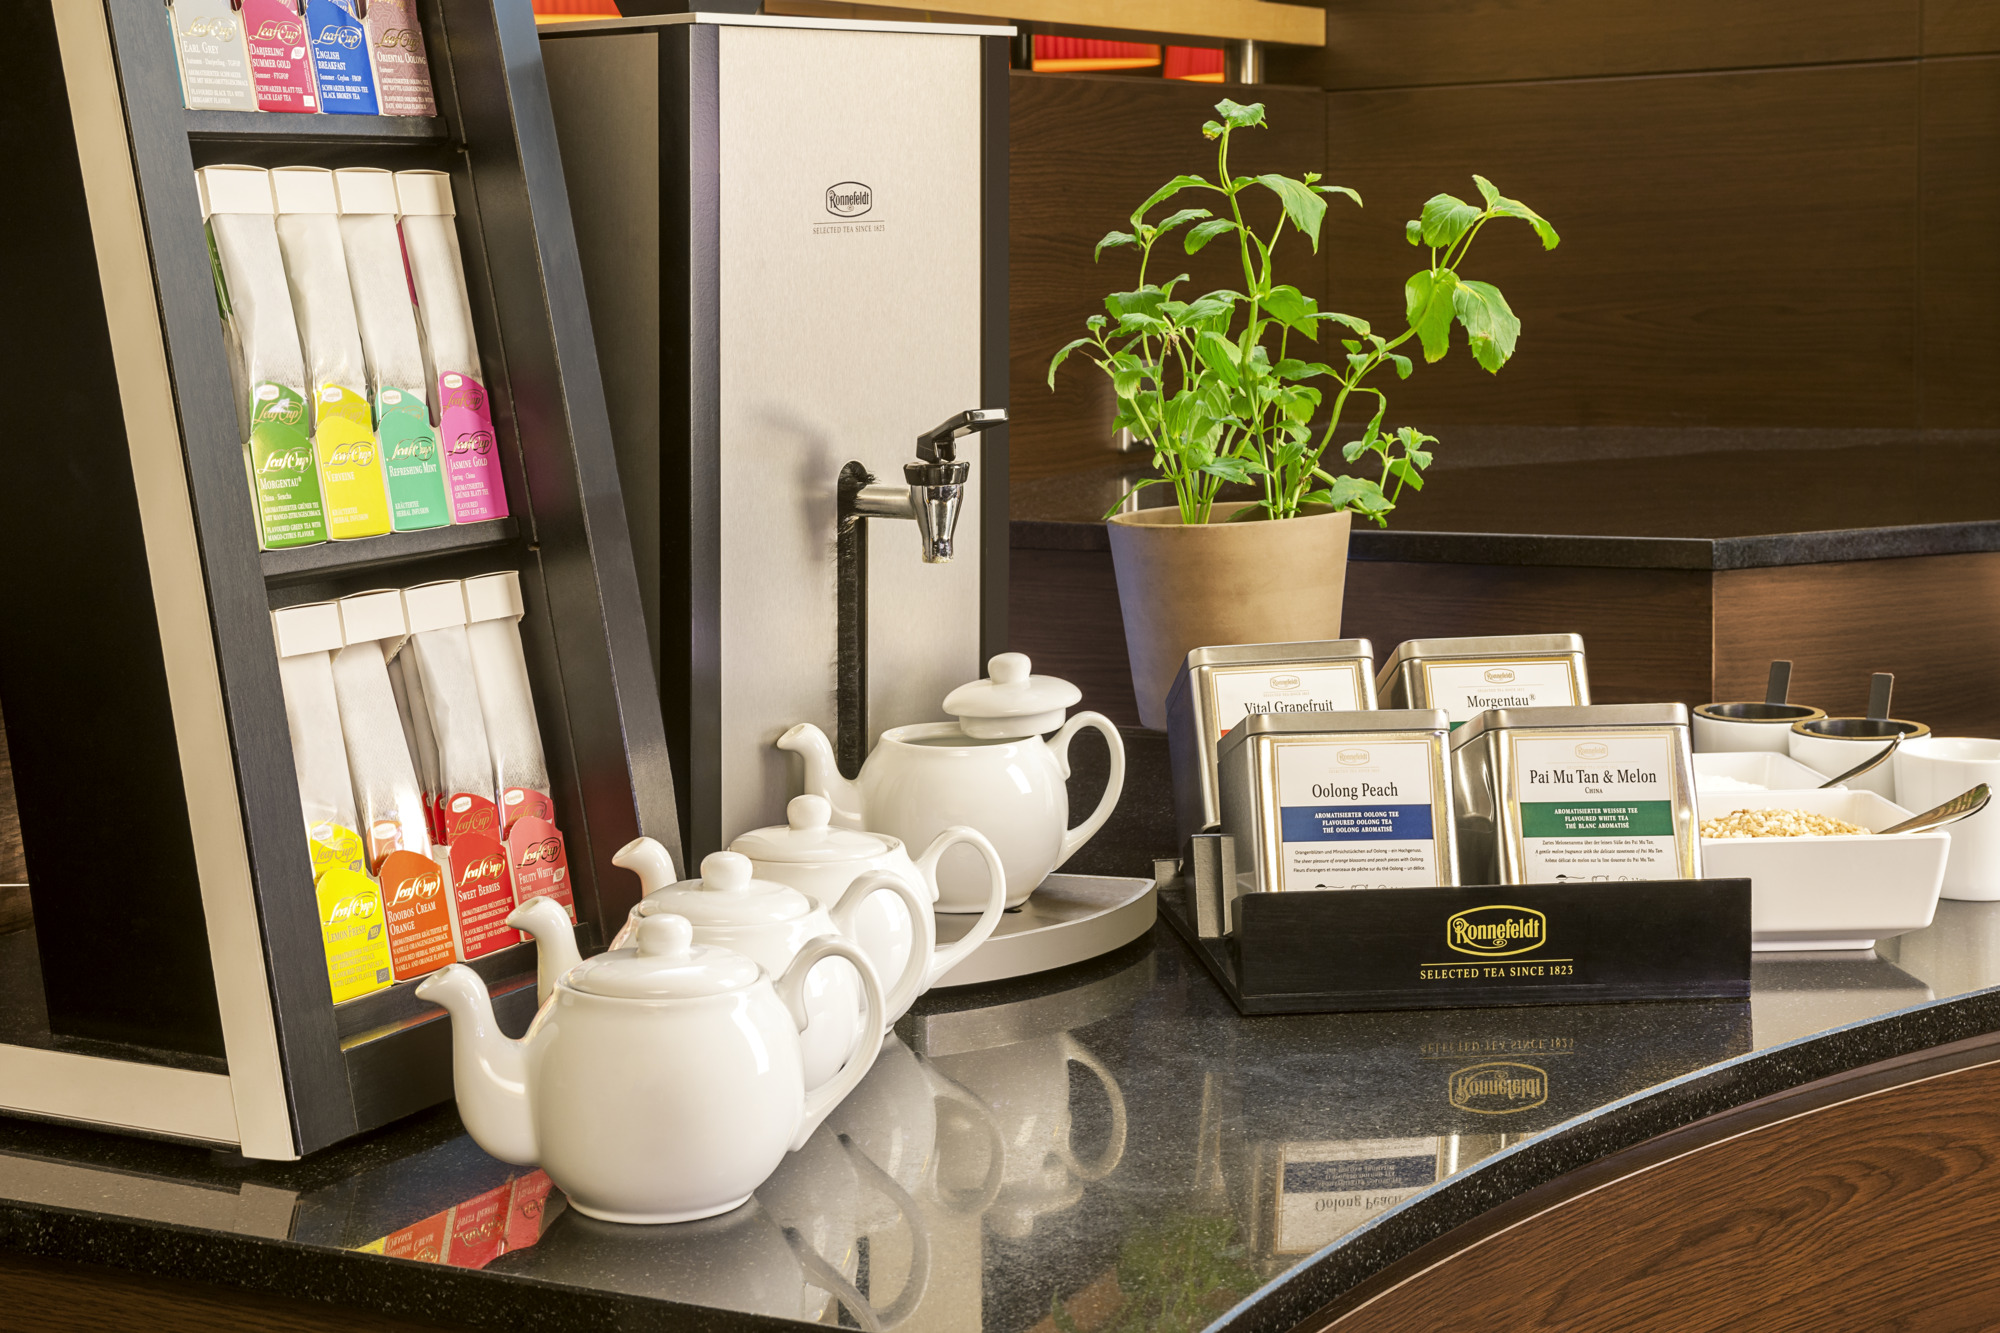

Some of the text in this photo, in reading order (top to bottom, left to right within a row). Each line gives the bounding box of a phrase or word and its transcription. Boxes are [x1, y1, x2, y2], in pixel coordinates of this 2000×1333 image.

[183, 40, 219, 54] EARL GREY
[315, 47, 340, 60] ENGLISH
[252, 59, 276, 68] SUMMER
[276, 59, 291, 69] GOLD
[377, 51, 404, 63] ORIENTAL
[317, 61, 346, 70] BREAKFAST
[828, 189, 869, 212] Ronnefeldt
[813, 226, 841, 234] SELECTED
[388, 462, 437, 477] REFRESHING MINT
[450, 456, 488, 473] JASMINE GOLD
[1244, 701, 1271, 714] Vital
[1530, 768, 1657, 784] Pai Mu Tan & Melon
[1312, 782, 1398, 800] Oolong Peach
[1361, 825, 1393, 833] AROMATISÉ
[518, 867, 554, 885] FRUITY WHITE
[458, 882, 500, 902] SWEET BERRIES
[387, 901, 437, 923] ROOIBOS CREAM
[389, 920, 415, 936] ORANGE
[1453, 917, 1540, 950] Ronnefeldt
[1420, 965, 1573, 980] SELECTED TEA SINCE 1823
